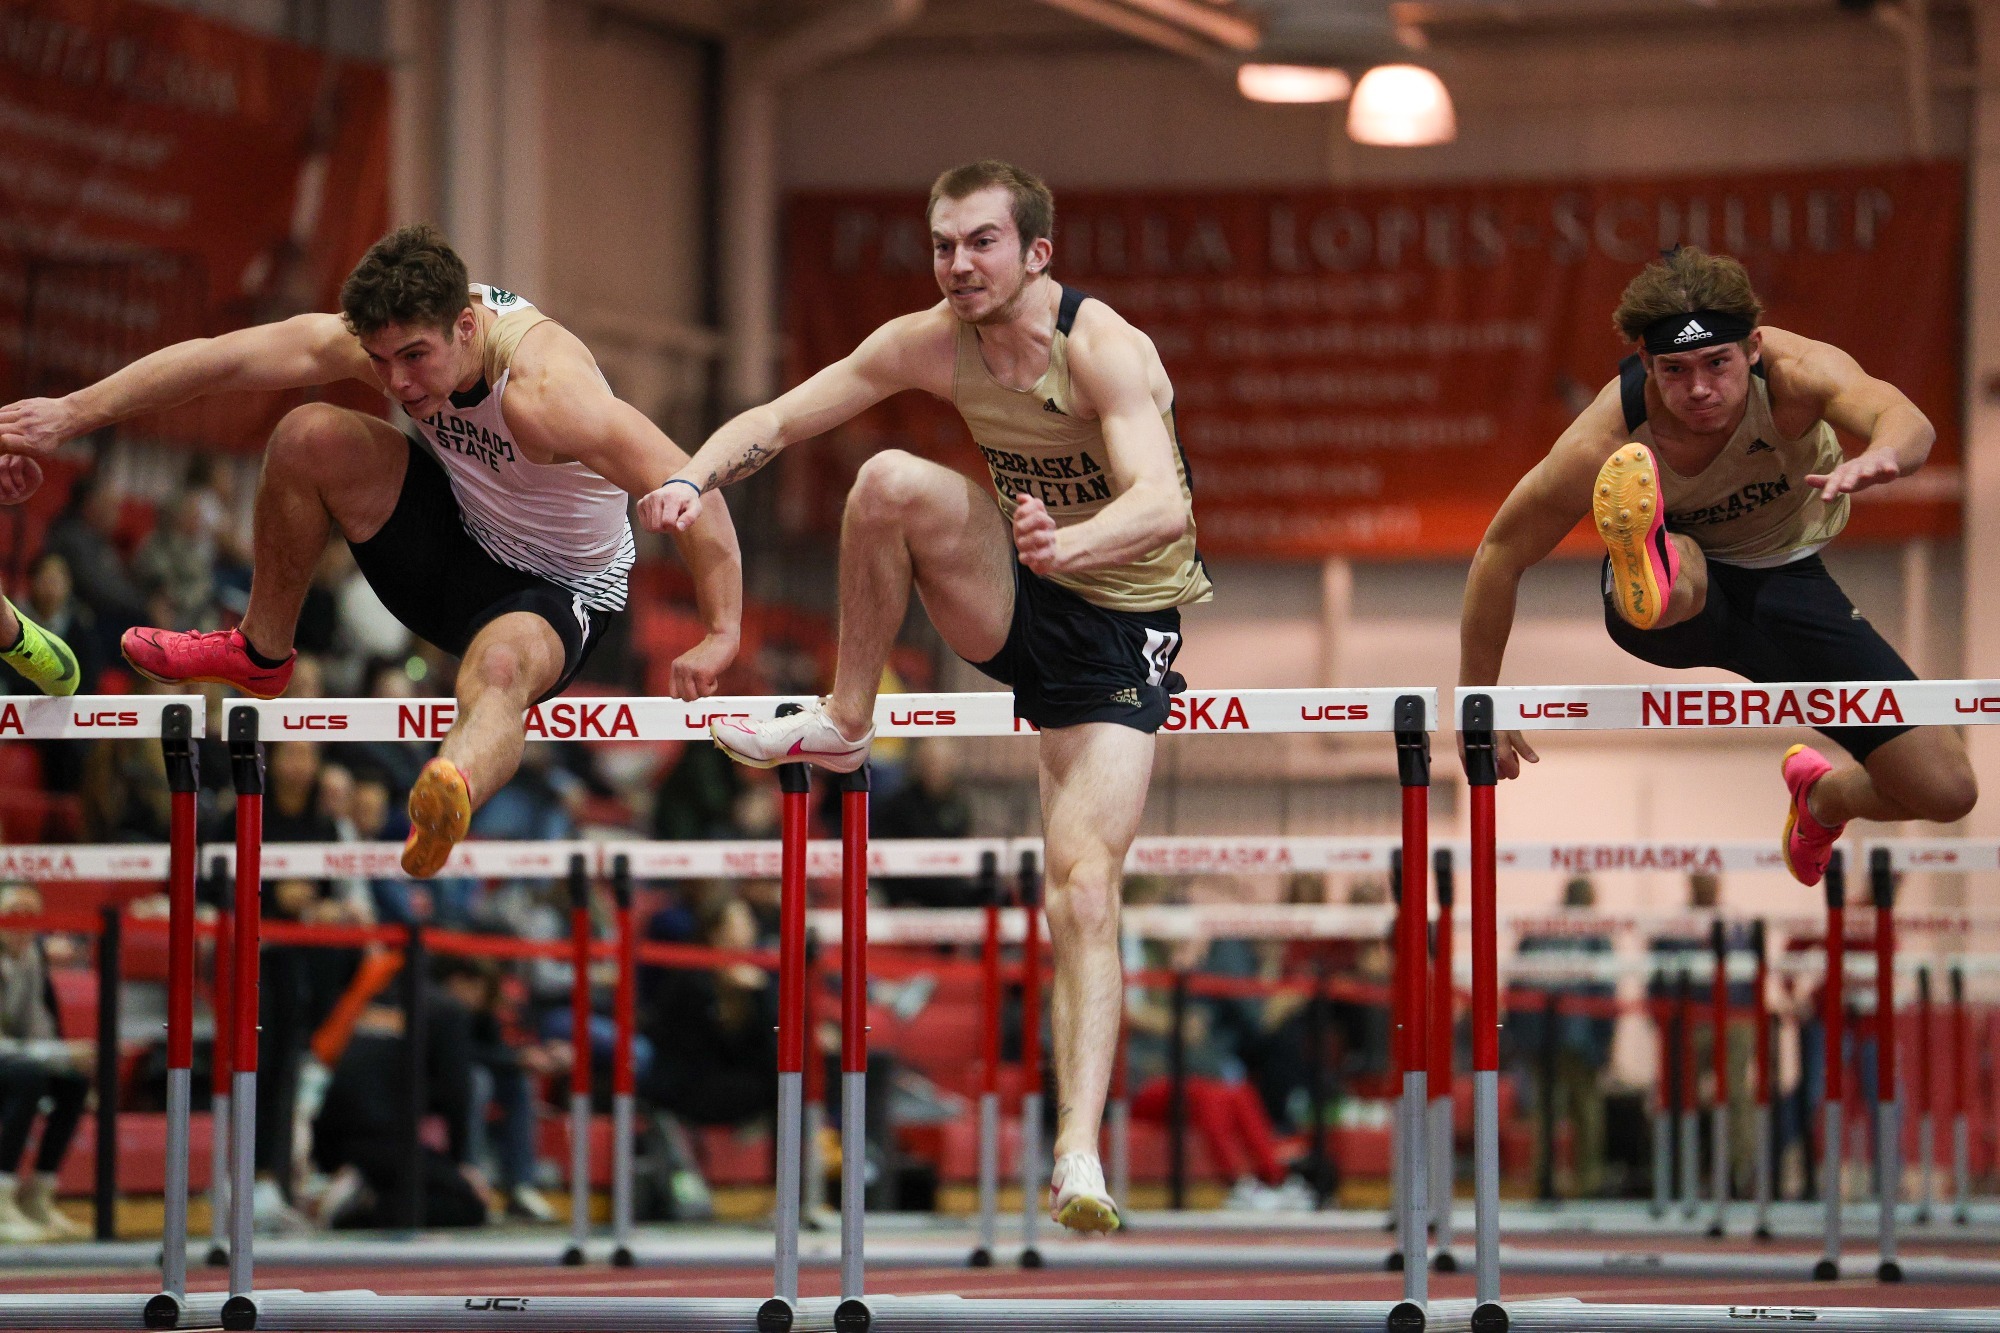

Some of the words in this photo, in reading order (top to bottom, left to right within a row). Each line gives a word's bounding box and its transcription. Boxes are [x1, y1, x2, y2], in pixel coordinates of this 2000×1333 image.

[1674, 332, 1713, 344] adidas
[436, 429, 500, 474] STATE
[891, 710, 956, 726] UCS
[1301, 704, 1368, 721] UCS
[1519, 702, 1589, 719] UCS
[1641, 688, 1904, 726] NEBRASKA
[1955, 697, 2000, 713] UC
[74, 711, 138, 727] UCS
[283, 715, 348, 730] UCS
[398, 704, 639, 738] NEASKA
[685, 713, 749, 729] UC
[1552, 846, 1723, 870] NEBRASKA
[1728, 1306, 1819, 1321] UCS
